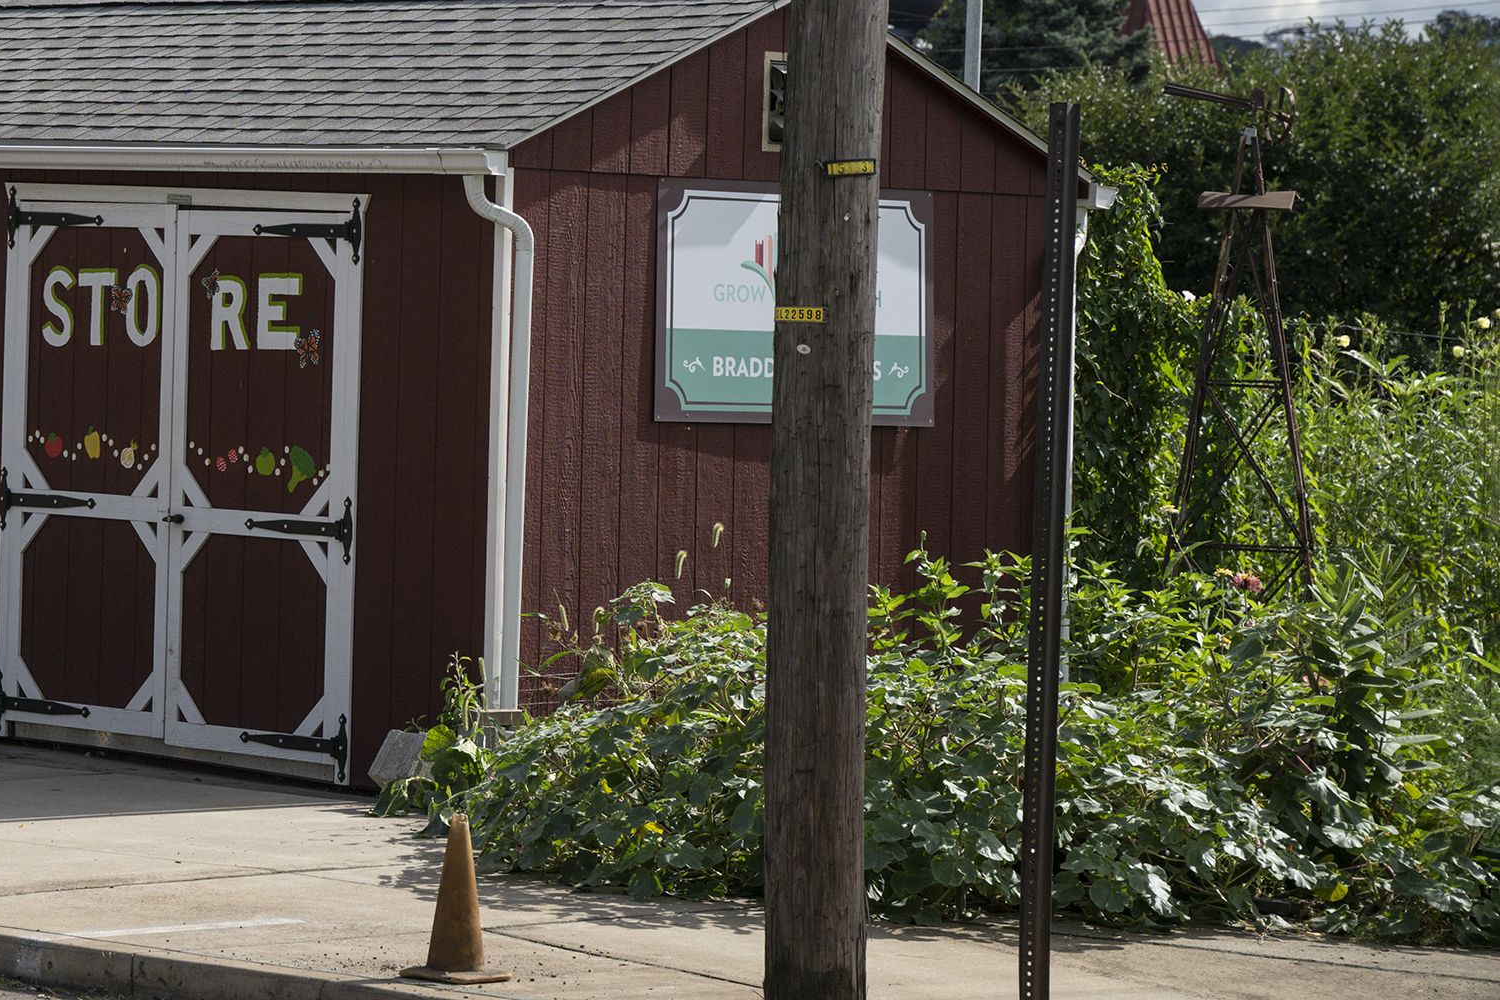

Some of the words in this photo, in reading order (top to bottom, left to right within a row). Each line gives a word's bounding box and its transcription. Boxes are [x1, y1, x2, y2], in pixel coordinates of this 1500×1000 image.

[713, 283, 766, 303] GROW
[42, 264, 303, 350] STORE
[713, 356, 774, 378] BRADD
